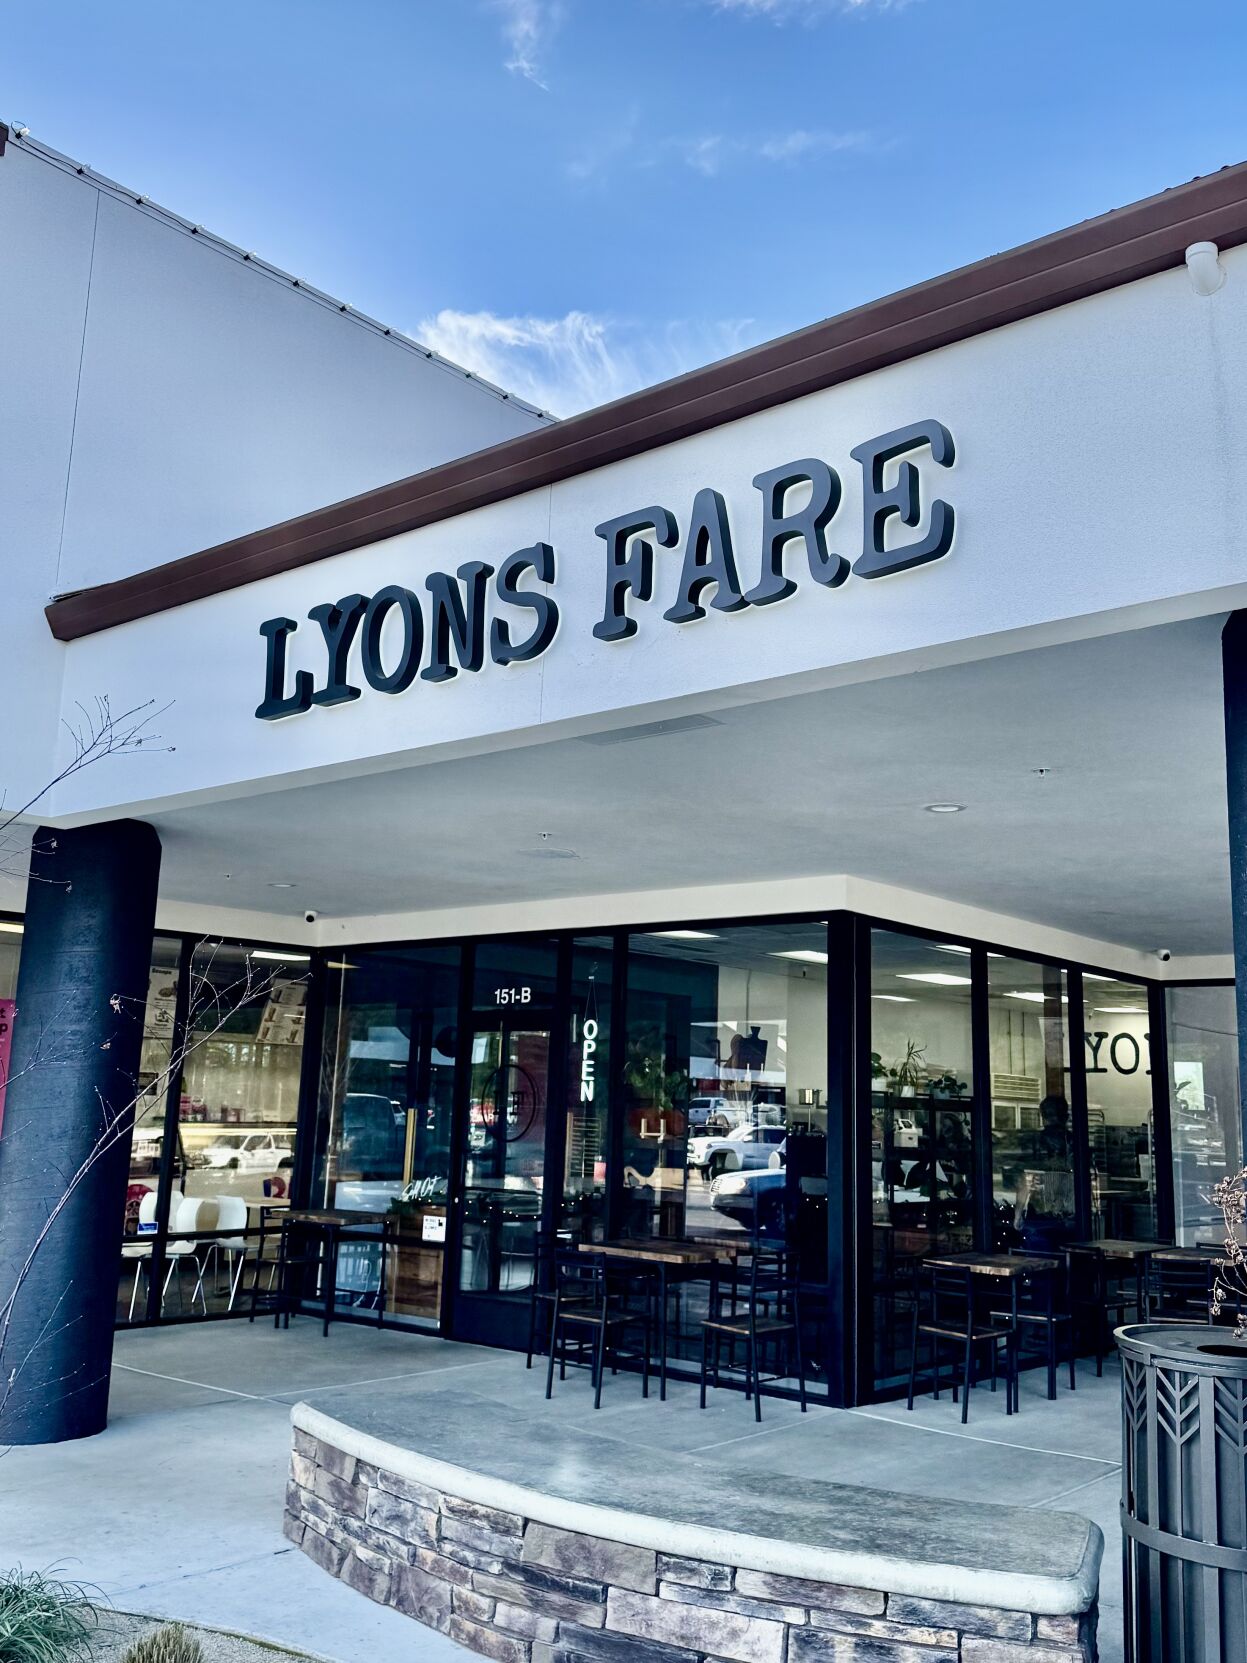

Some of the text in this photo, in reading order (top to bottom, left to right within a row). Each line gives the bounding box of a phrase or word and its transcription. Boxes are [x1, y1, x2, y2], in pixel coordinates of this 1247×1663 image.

[255, 418, 956, 720] LYONS FARE
[494, 986, 532, 1005] 151-B
[580, 1018, 599, 1102] OPEN
[1062, 1031, 1152, 1076] YO
